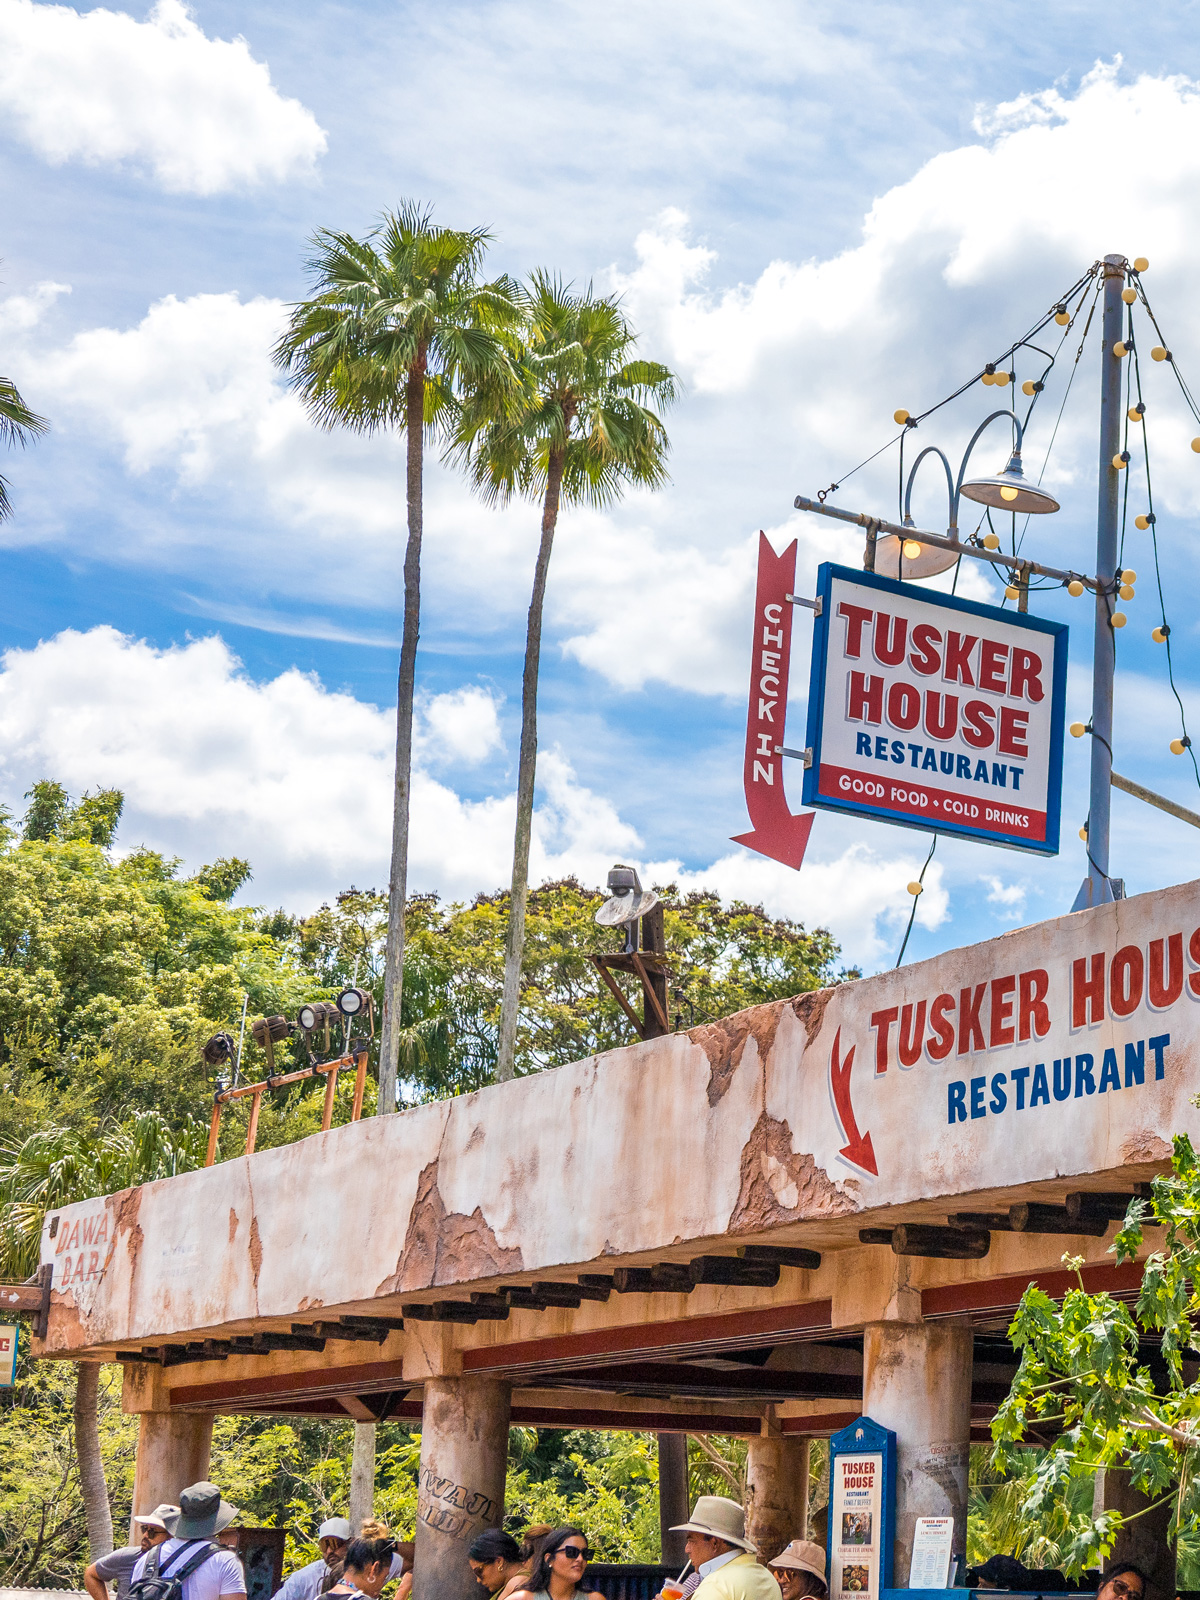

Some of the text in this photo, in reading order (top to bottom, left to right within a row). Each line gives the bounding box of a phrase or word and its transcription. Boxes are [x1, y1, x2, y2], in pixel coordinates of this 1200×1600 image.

[837, 602, 1045, 703] TUSKER
[753, 603, 783, 786] CHECK IN
[846, 670, 1030, 760] HOUSE
[855, 731, 1024, 791] RESTAURANT
[838, 774, 1030, 828] GOOD FOOD COLD DRINKS
[870, 968, 1051, 1078] TUSKER
[947, 1033, 1171, 1125] RESTAURANT
[55, 1213, 108, 1255] DAWA
[61, 1251, 99, 1287] BAR
[842, 1462, 875, 1475] TUSKER
[844, 1476, 874, 1489] HOUSE
